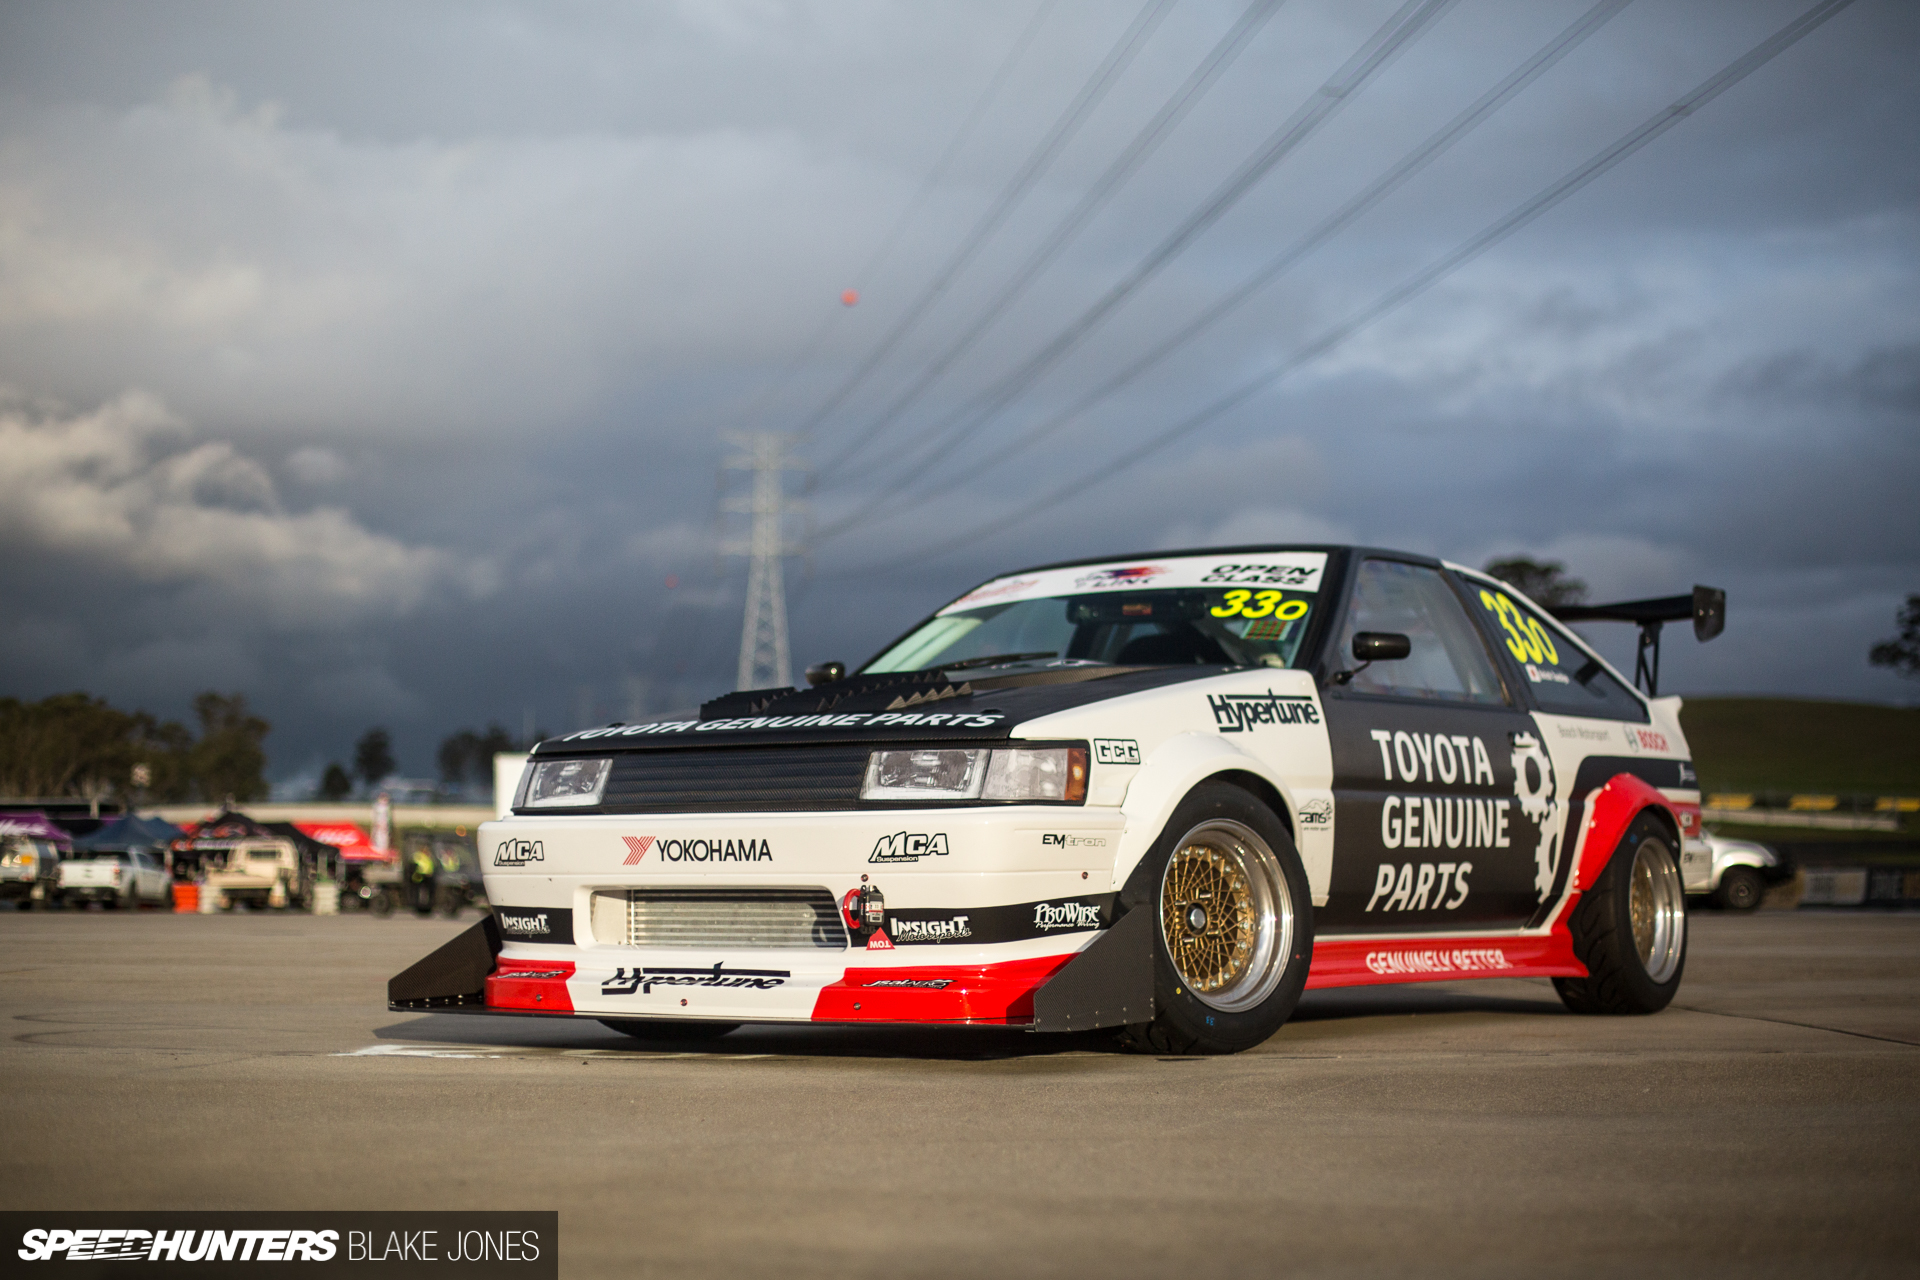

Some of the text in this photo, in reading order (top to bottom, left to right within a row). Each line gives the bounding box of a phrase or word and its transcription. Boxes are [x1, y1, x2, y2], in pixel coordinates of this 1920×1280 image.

[1200, 574, 1308, 585] CLASS
[1211, 564, 1319, 576] OPEN
[1210, 588, 1309, 620] 330
[1479, 589, 1559, 665] 330
[1207, 688, 1320, 733] Hypertune
[562, 712, 1005, 742] TOYOTA GENUINE PARTS
[1370, 729, 1495, 786] TOYOTA
[1381, 795, 1511, 849] GENUINE
[494, 838, 545, 866] MCA
[656, 838, 773, 862] YOKOHAMA
[868, 830, 949, 863] MCA
[1042, 833, 1106, 849] EMtron
[1365, 861, 1473, 912] PARTS
[501, 912, 548, 931] INSIGHT
[890, 915, 969, 936] INSIGHT
[895, 926, 972, 943] Motorsports
[869, 940, 891, 949] TOW
[1365, 948, 1514, 975] GENUINELY BETTER
[601, 961, 791, 995] Hypertune
